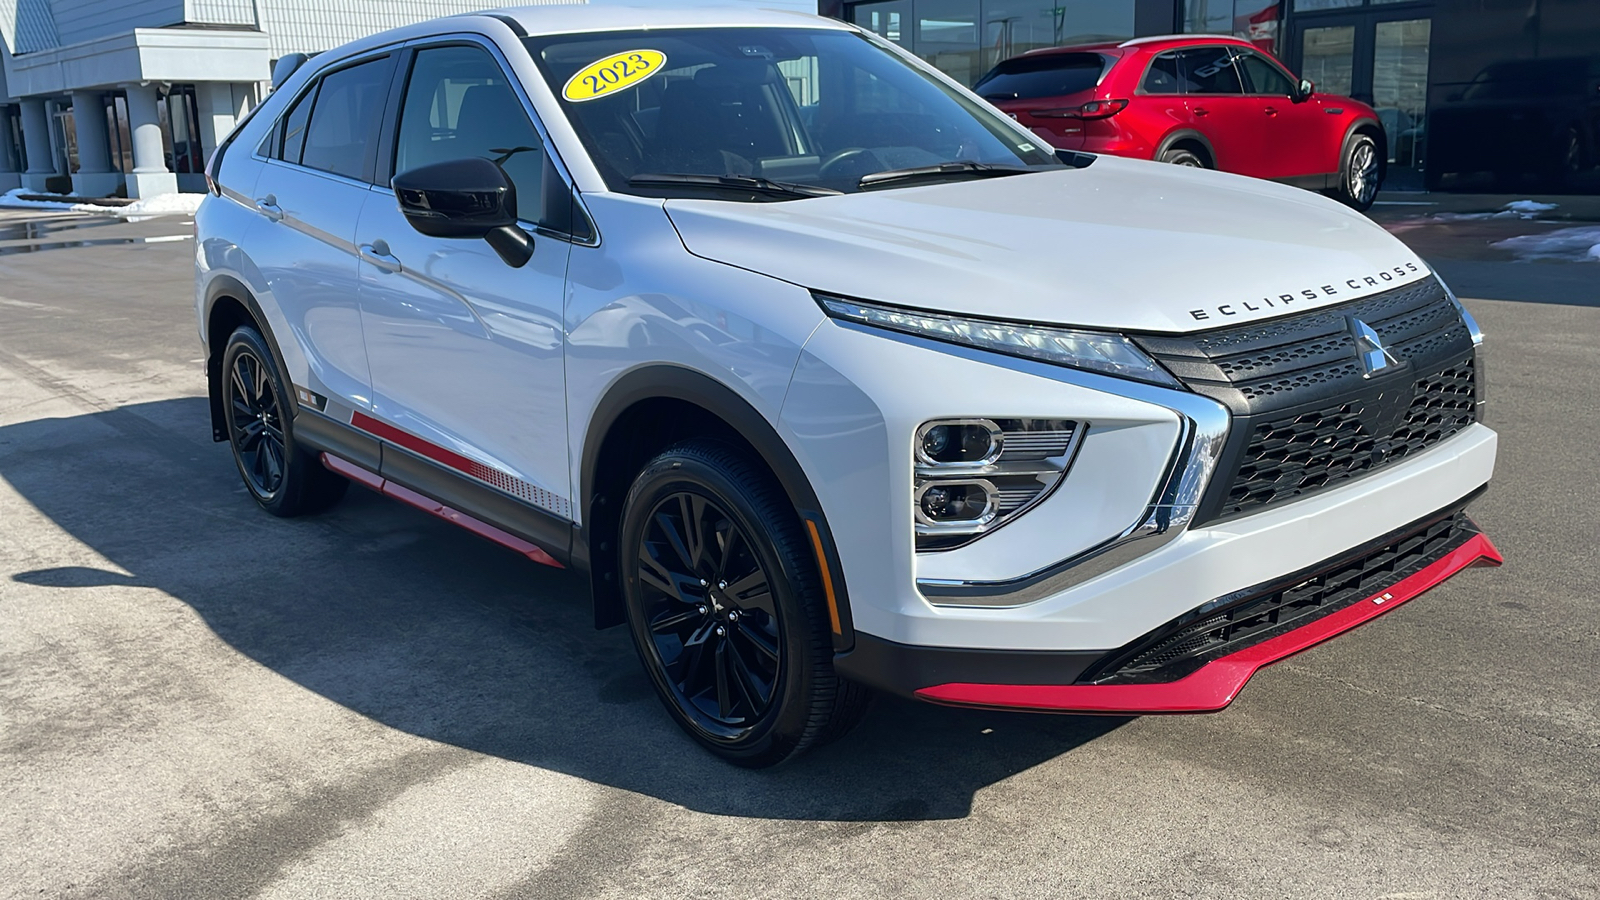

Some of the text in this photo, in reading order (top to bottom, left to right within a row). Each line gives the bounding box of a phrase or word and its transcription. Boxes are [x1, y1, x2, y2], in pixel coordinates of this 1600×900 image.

[582, 53, 650, 94] 2023
[1189, 262, 1418, 321] ECLIPSE CROSS
